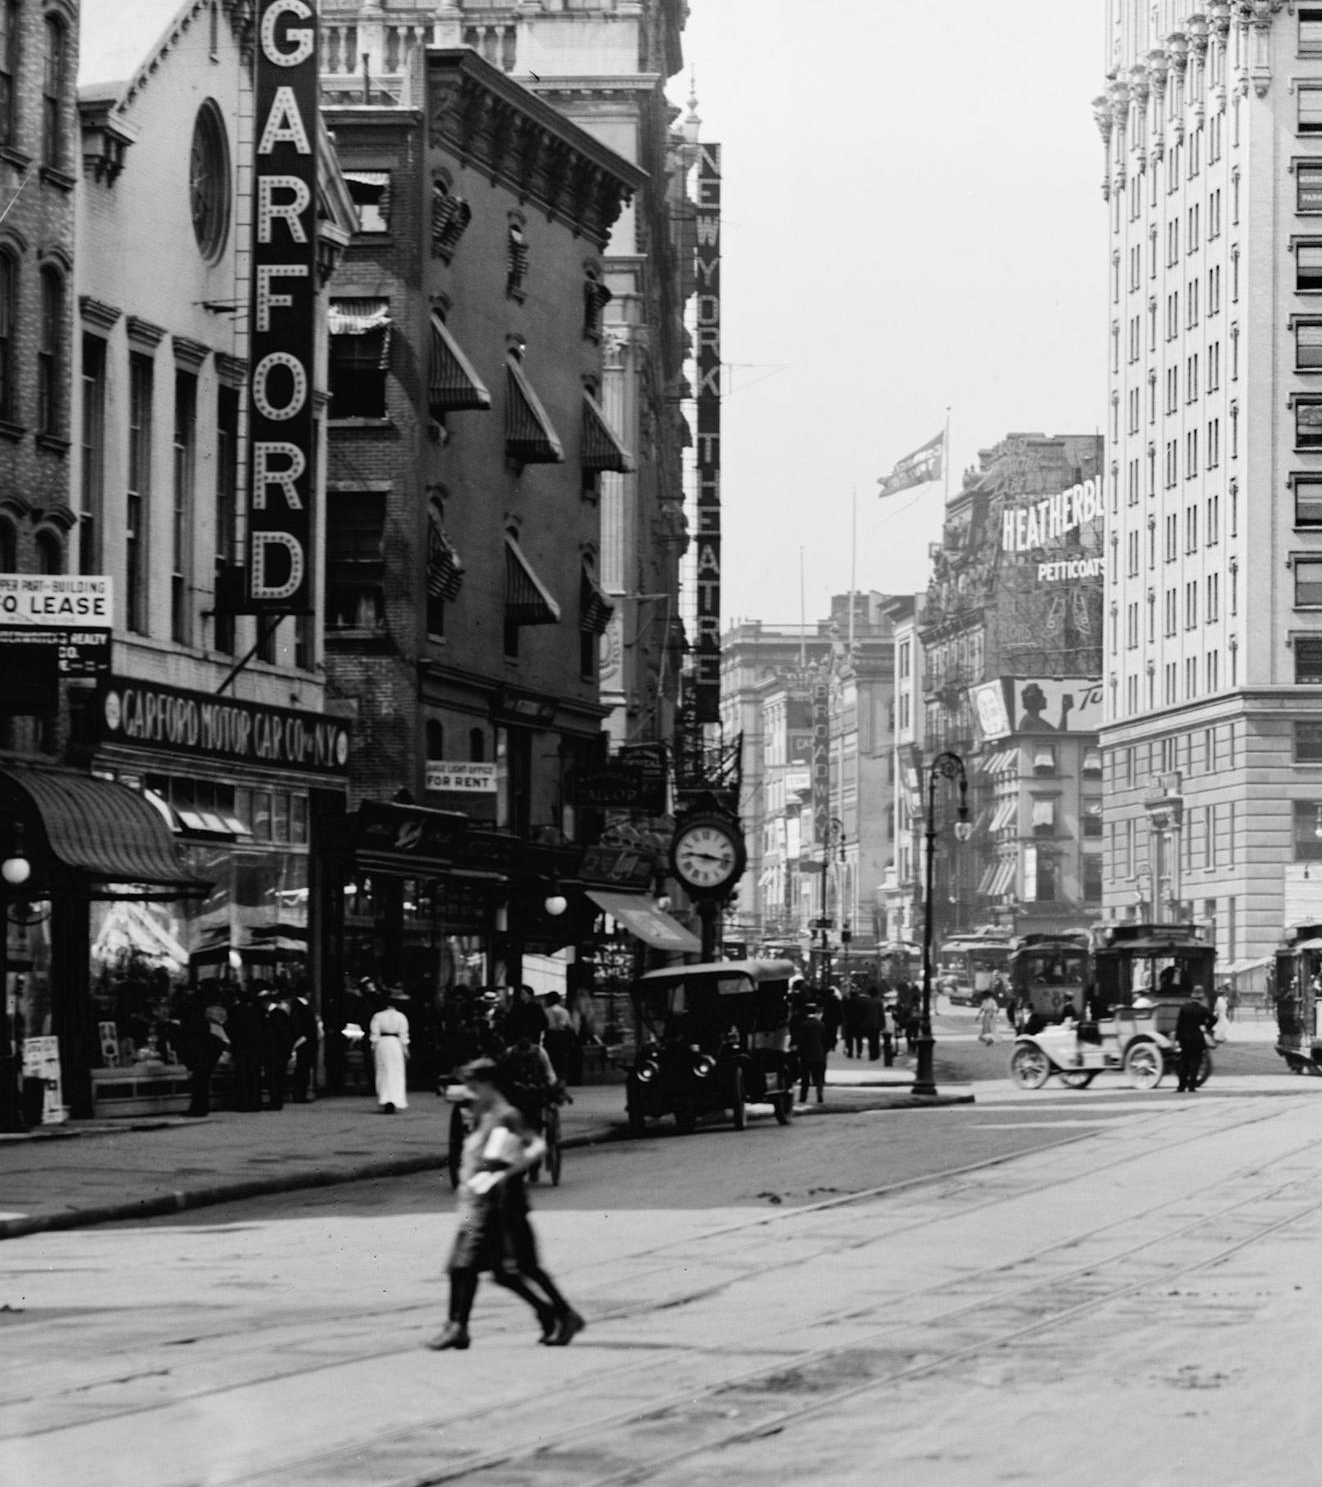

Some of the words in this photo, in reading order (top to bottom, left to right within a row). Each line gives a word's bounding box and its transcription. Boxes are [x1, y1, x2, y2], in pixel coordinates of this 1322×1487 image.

[697, 145, 721, 246] NEW
[697, 256, 721, 398] YORK
[1002, 474, 1104, 552] HEATHERBL
[695, 434, 721, 685] THEATRE
[0, 594, 17, 613] O
[30, 595, 106, 616] LEASE
[121, 688, 200, 746] GARFORD
[200, 701, 251, 756] MOTOR
[254, 713, 283, 761] CAR
[814, 683, 829, 838] BROADWAY
[426, 775, 451, 786] FOR
[455, 777, 490, 788] RENT
